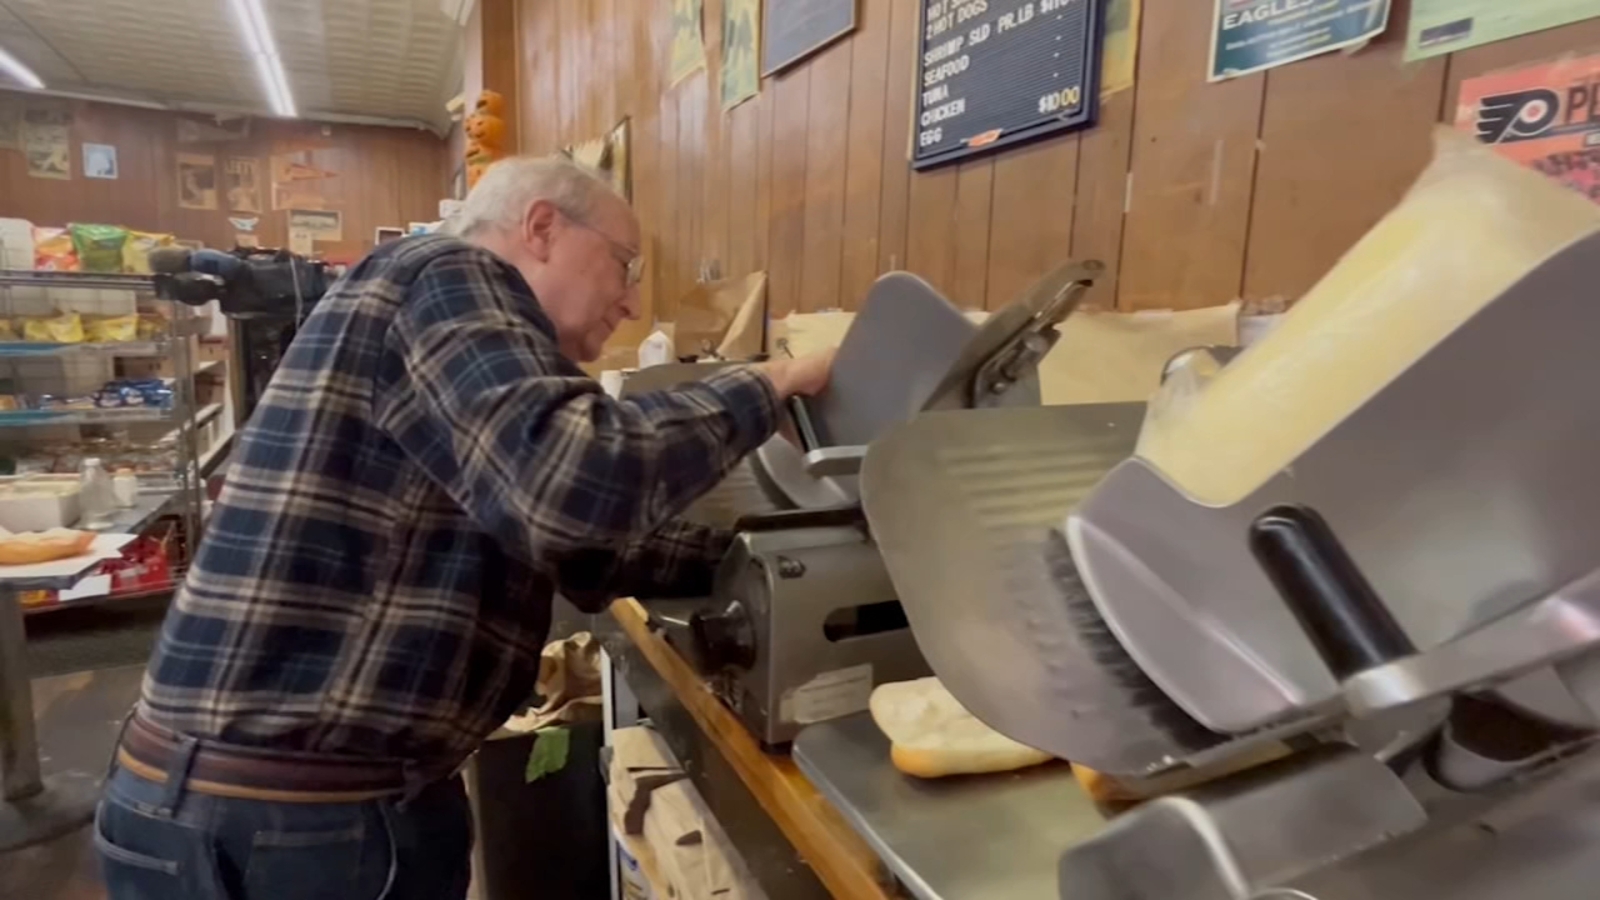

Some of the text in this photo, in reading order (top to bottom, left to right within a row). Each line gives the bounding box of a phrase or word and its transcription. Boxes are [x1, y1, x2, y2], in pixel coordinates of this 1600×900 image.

[957, 0, 988, 23] DOGS
[924, 36, 963, 66] SHRIMP
[969, 24, 990, 46] SLD
[924, 55, 970, 86] SEAFOOD
[922, 85, 948, 106] TUNA
[921, 98, 966, 126] CHICKEN
[920, 127, 942, 146] EGG
